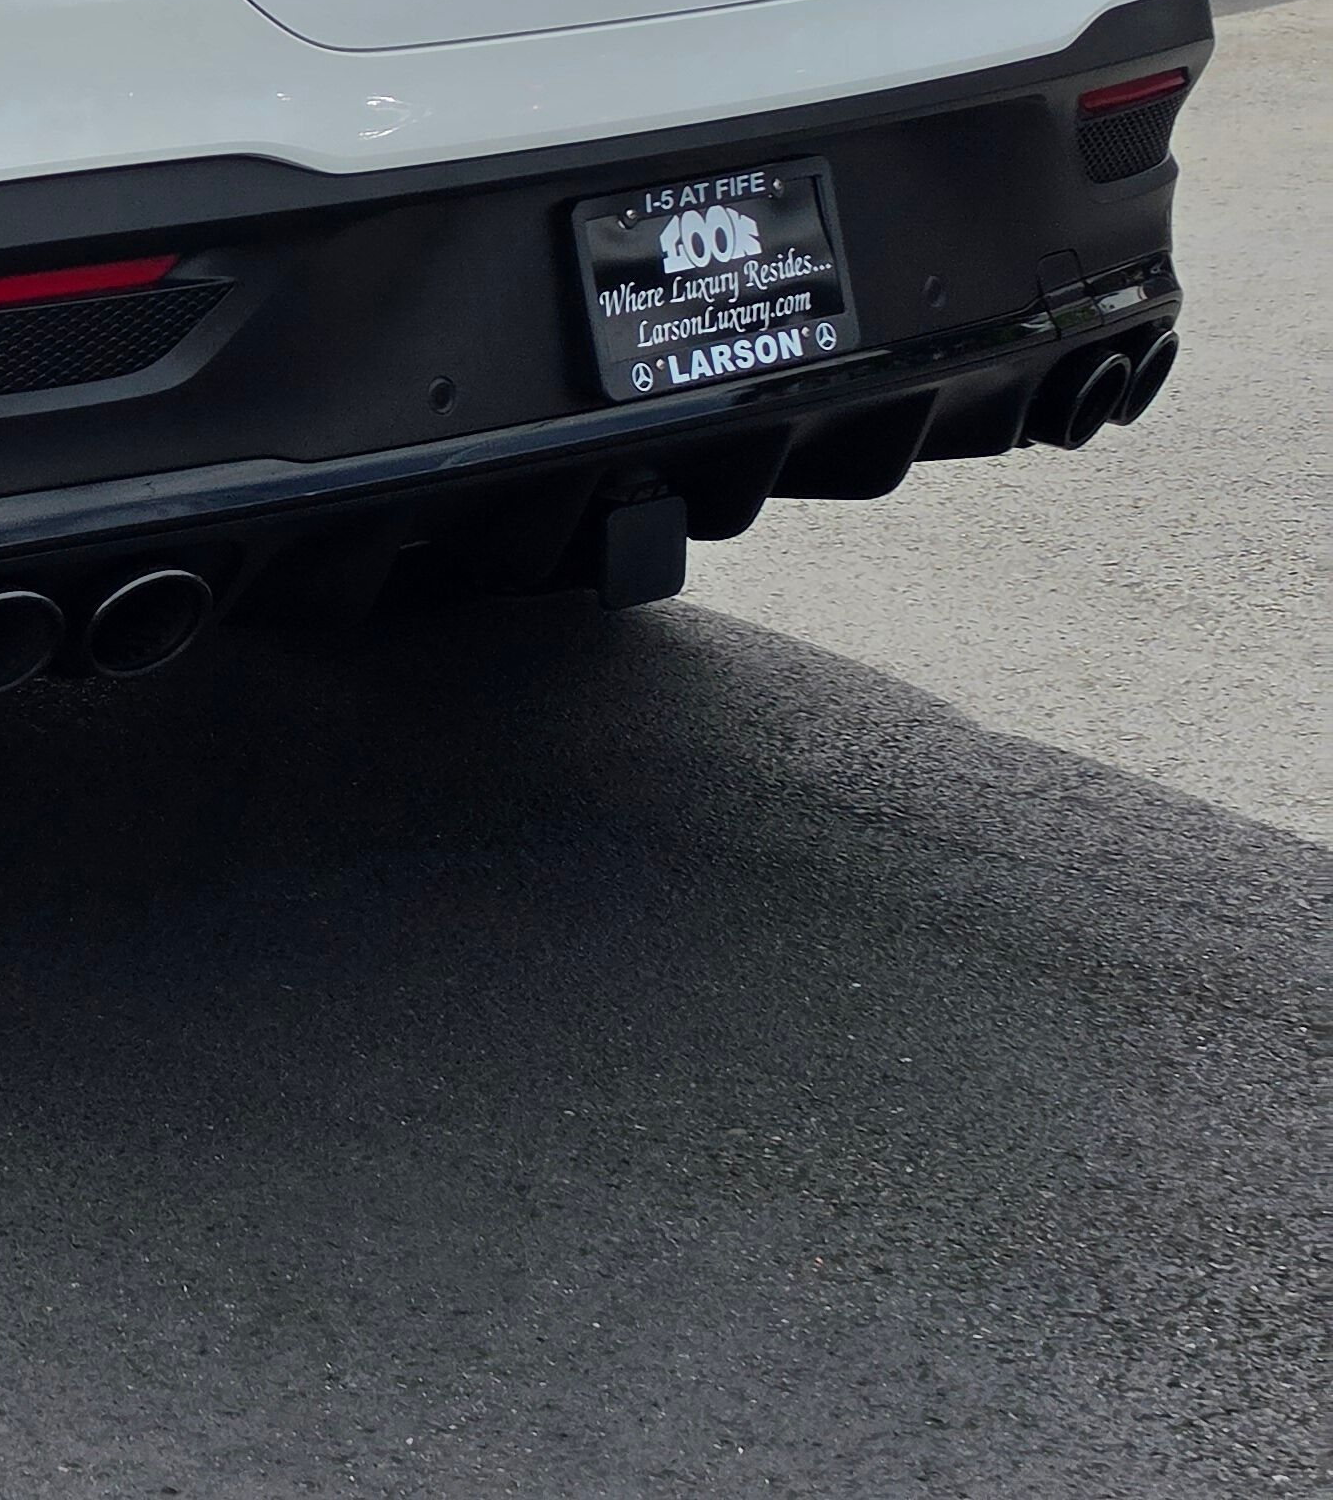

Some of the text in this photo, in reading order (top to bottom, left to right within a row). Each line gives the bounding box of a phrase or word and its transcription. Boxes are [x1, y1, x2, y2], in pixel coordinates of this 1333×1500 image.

[645, 171, 766, 213] I-5 AT FIFE
[659, 205, 763, 274] LOOK
[599, 247, 833, 318] Where Luxury Resides...
[636, 289, 812, 348] LarsonLuxury.com
[667, 328, 804, 385] LARSON
